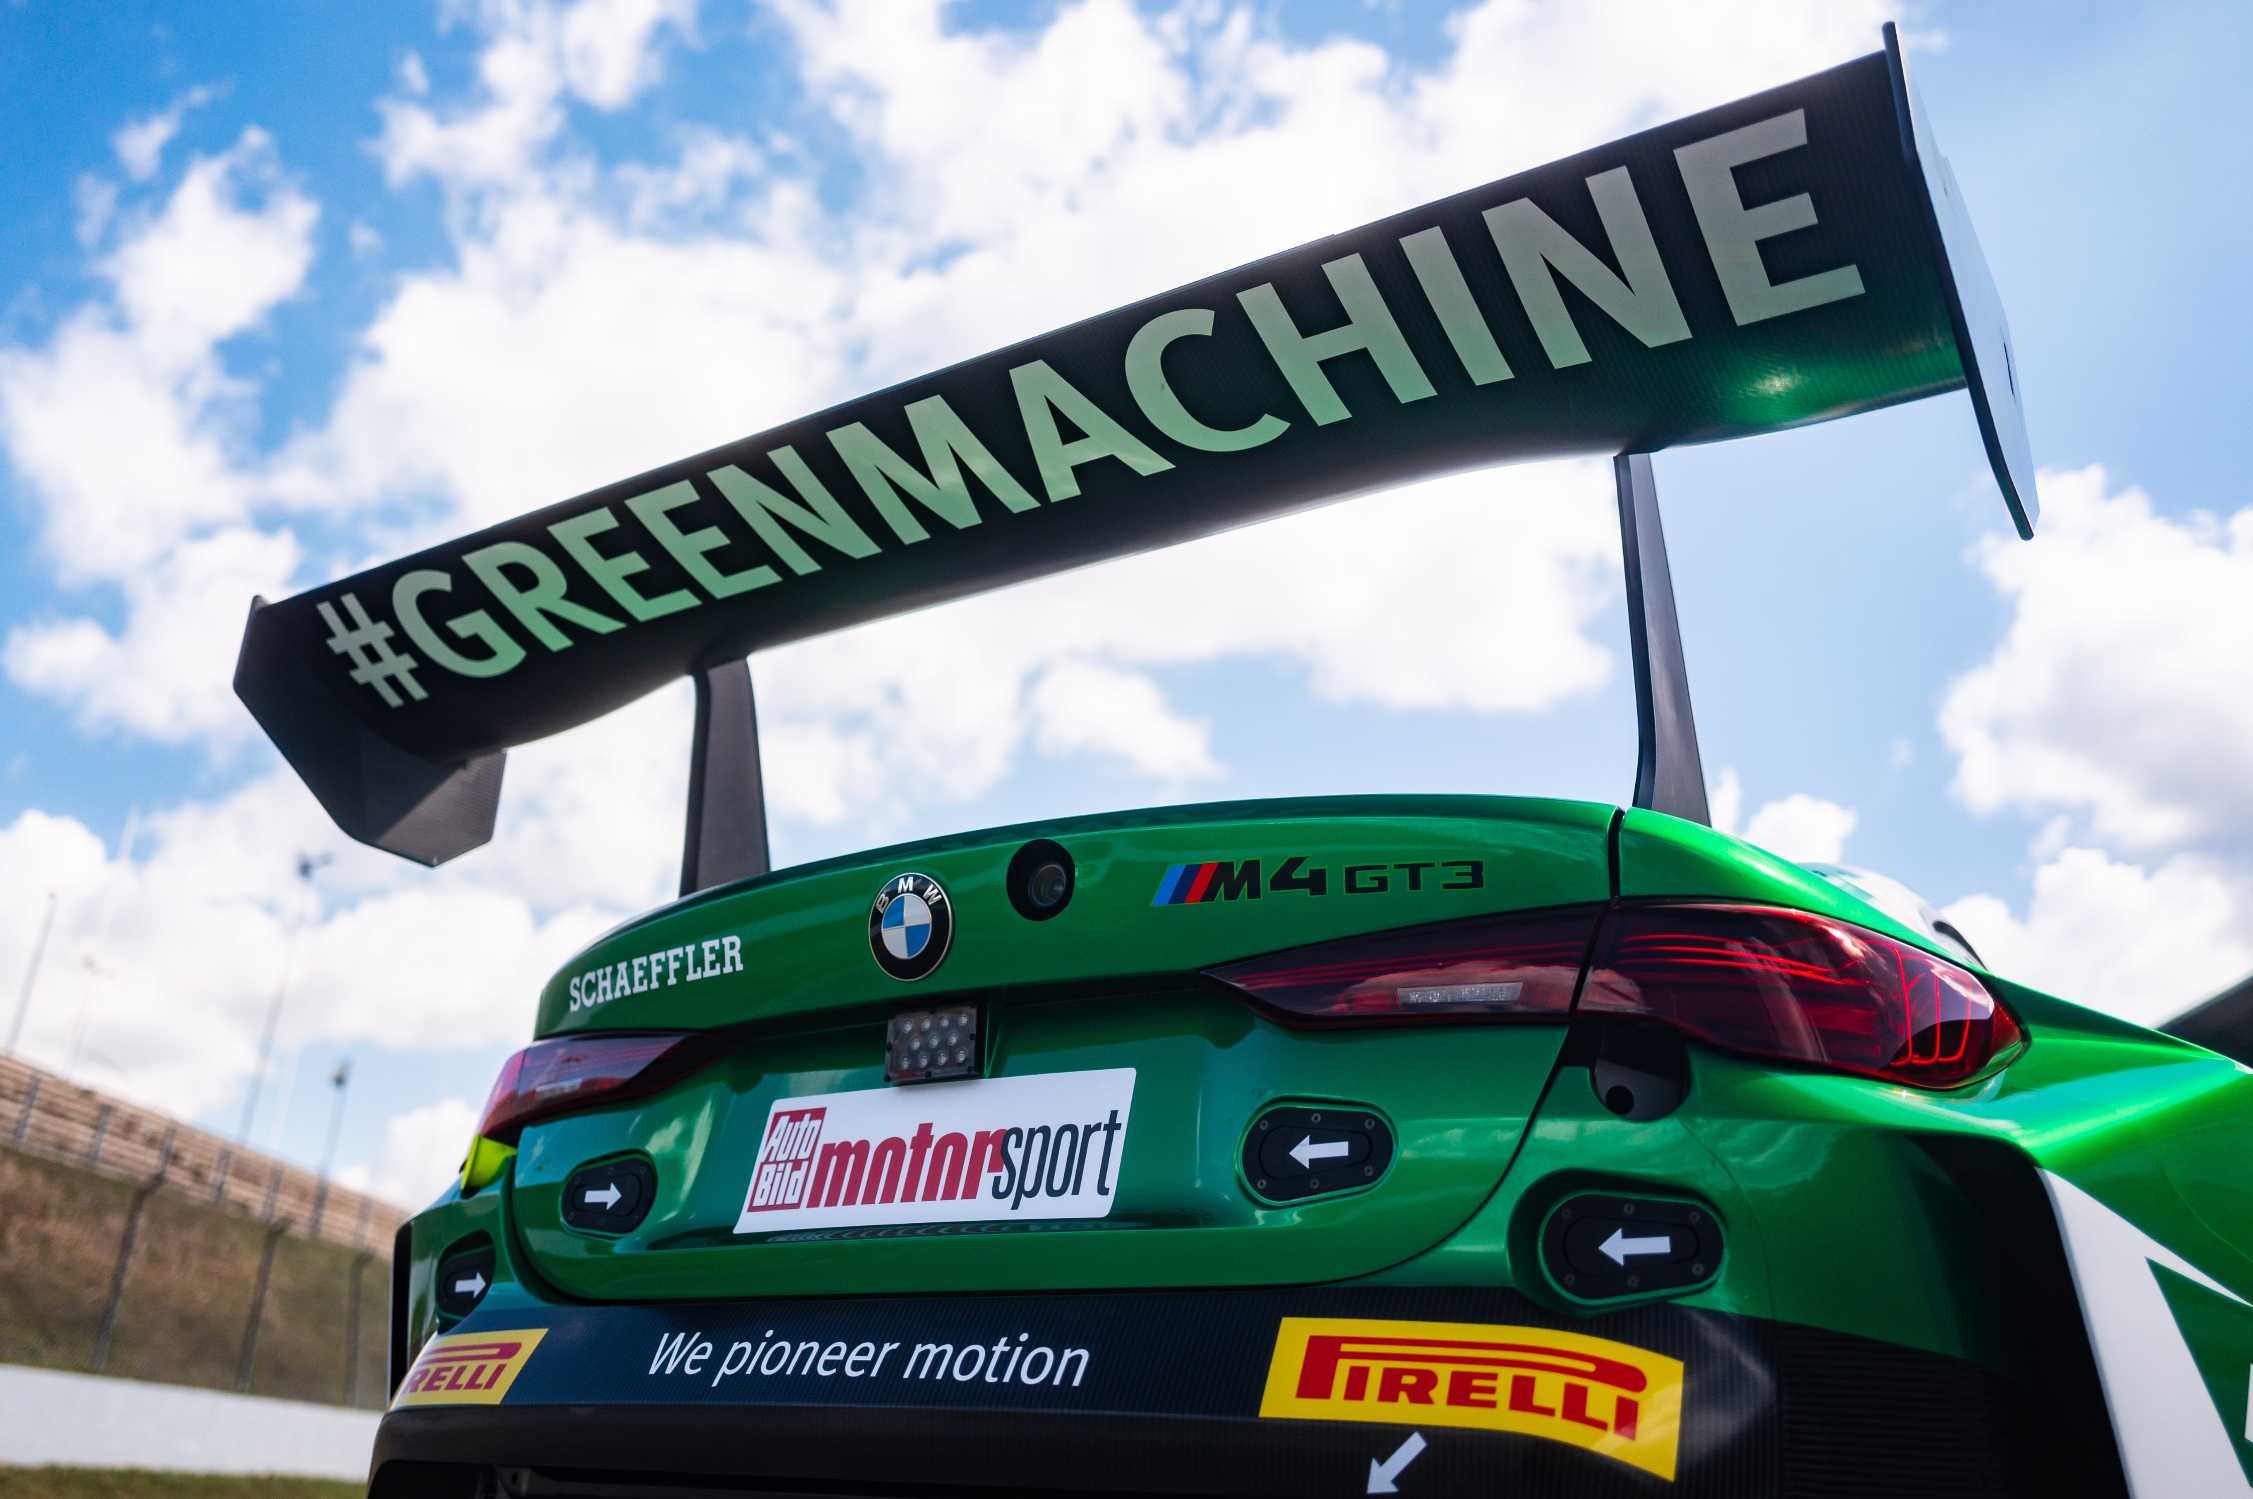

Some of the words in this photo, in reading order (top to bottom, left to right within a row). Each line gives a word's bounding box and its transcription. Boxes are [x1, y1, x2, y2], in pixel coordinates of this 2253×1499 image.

[317, 108, 1866, 709] #GREENMACHINE
[875, 876, 942, 914] BMW
[1200, 856, 1327, 901] M4
[1344, 860, 1484, 894] GT3
[568, 935, 743, 1013] SCHAEFFLER
[763, 1112, 823, 1162] Auto
[752, 1161, 808, 1207] Bild
[401, 1341, 522, 1393] RELLI
[648, 1332, 713, 1375] We
[711, 1329, 899, 1387] pioneer
[902, 1332, 1090, 1387] motion
[1295, 1335, 1648, 1441] PIRELLI
